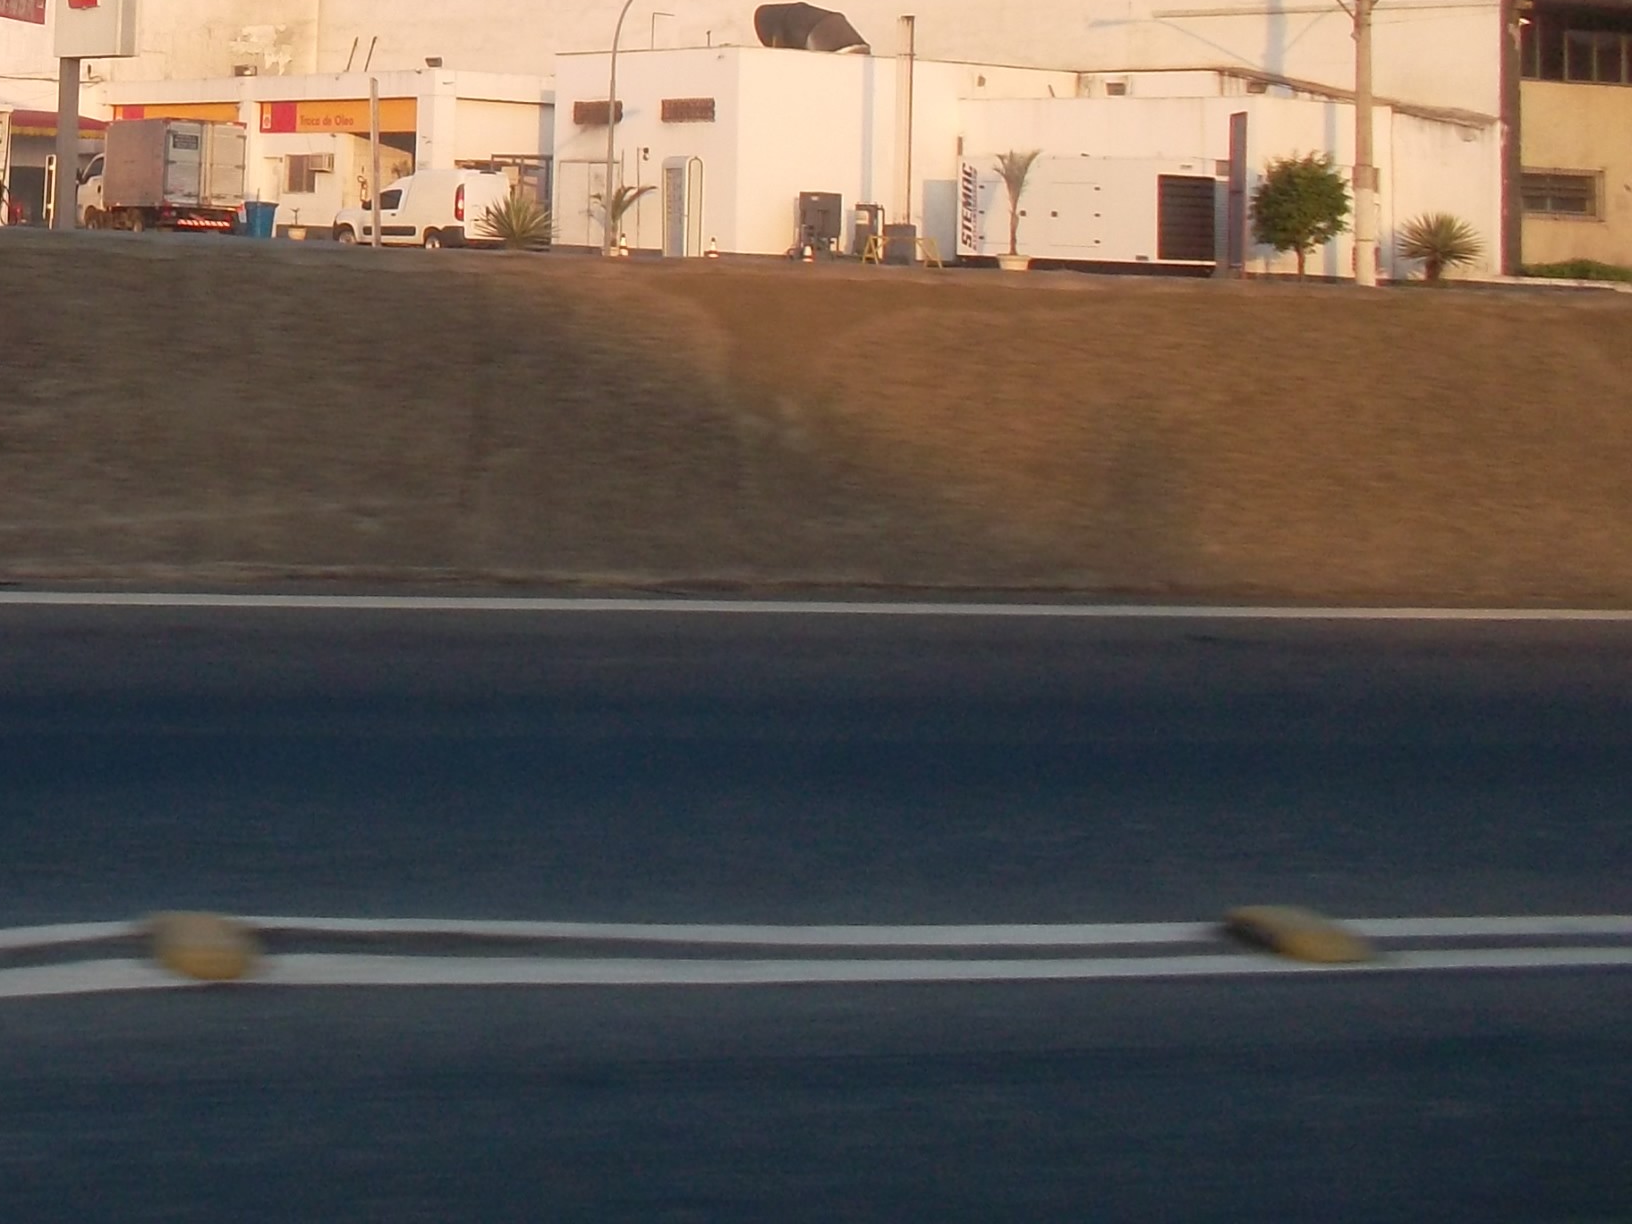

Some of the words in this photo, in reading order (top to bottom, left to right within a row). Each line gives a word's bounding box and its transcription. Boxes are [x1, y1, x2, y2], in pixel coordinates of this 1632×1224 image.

[300, 115, 320, 126] Troca
[322, 115, 332, 126] de
[961, 162, 973, 248] STEMAC
